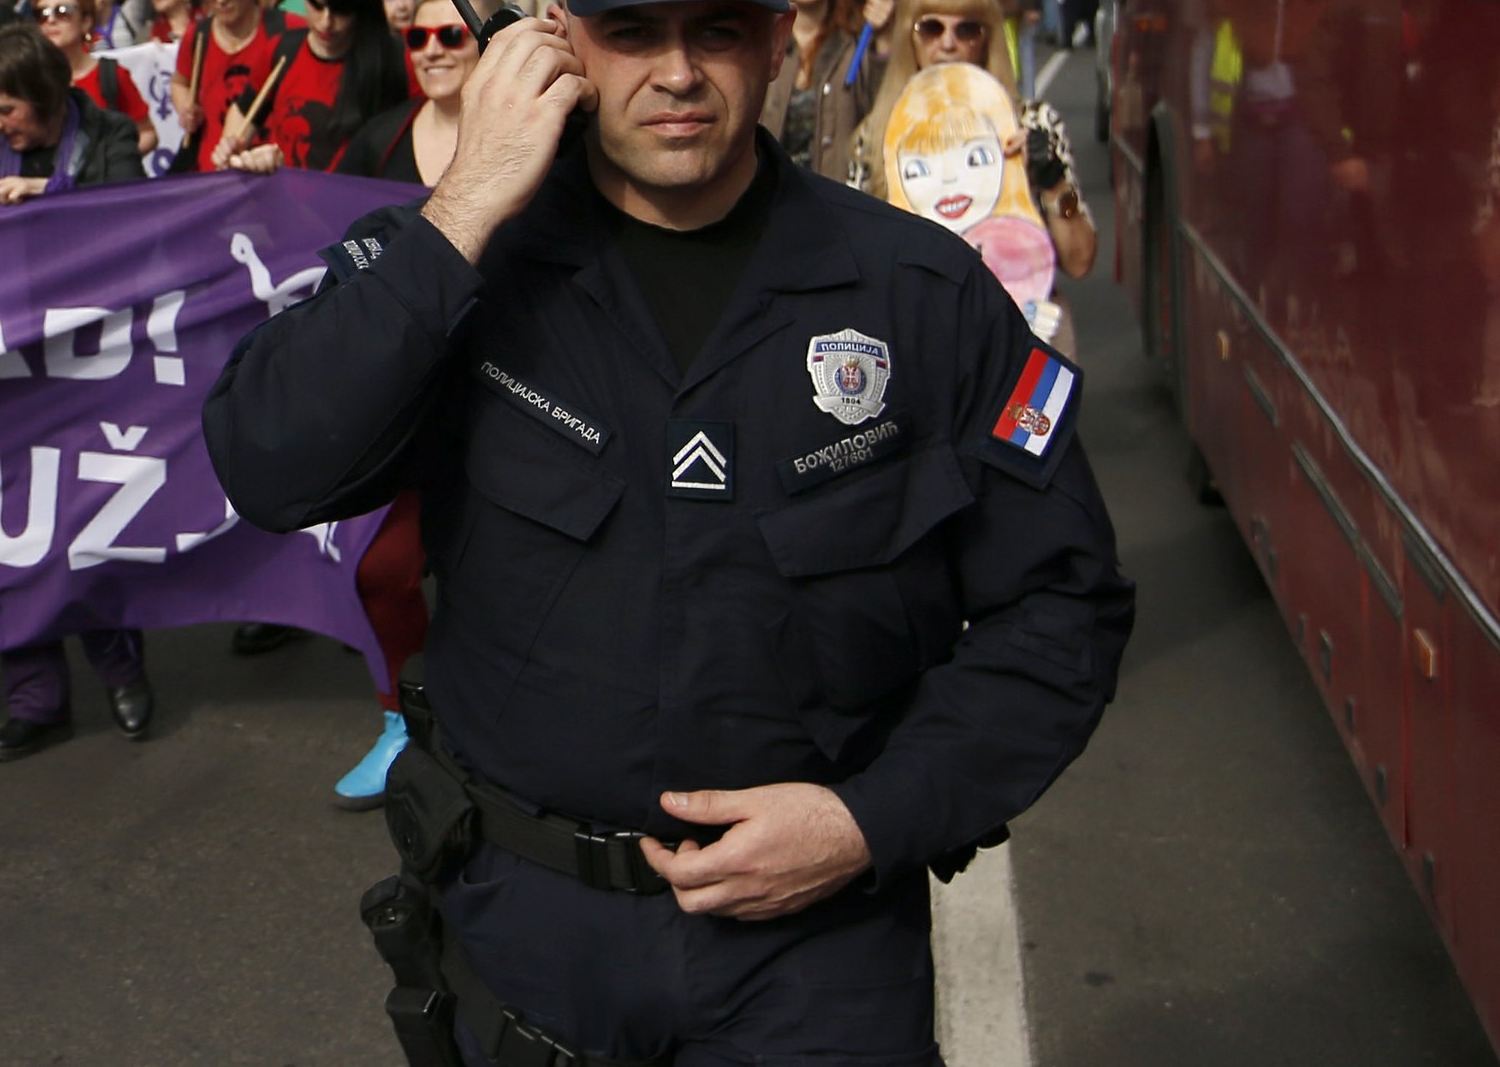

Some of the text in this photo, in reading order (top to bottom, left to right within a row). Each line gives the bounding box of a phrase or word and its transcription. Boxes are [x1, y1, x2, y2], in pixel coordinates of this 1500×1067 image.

[820, 342, 881, 356] ПОЛИЦИЈА
[480, 362, 601, 444] ПОЛИЦИЈСКА БРИГАДА
[841, 397, 862, 405] 1804
[794, 421, 899, 473] БОЖИЛОВИЋ
